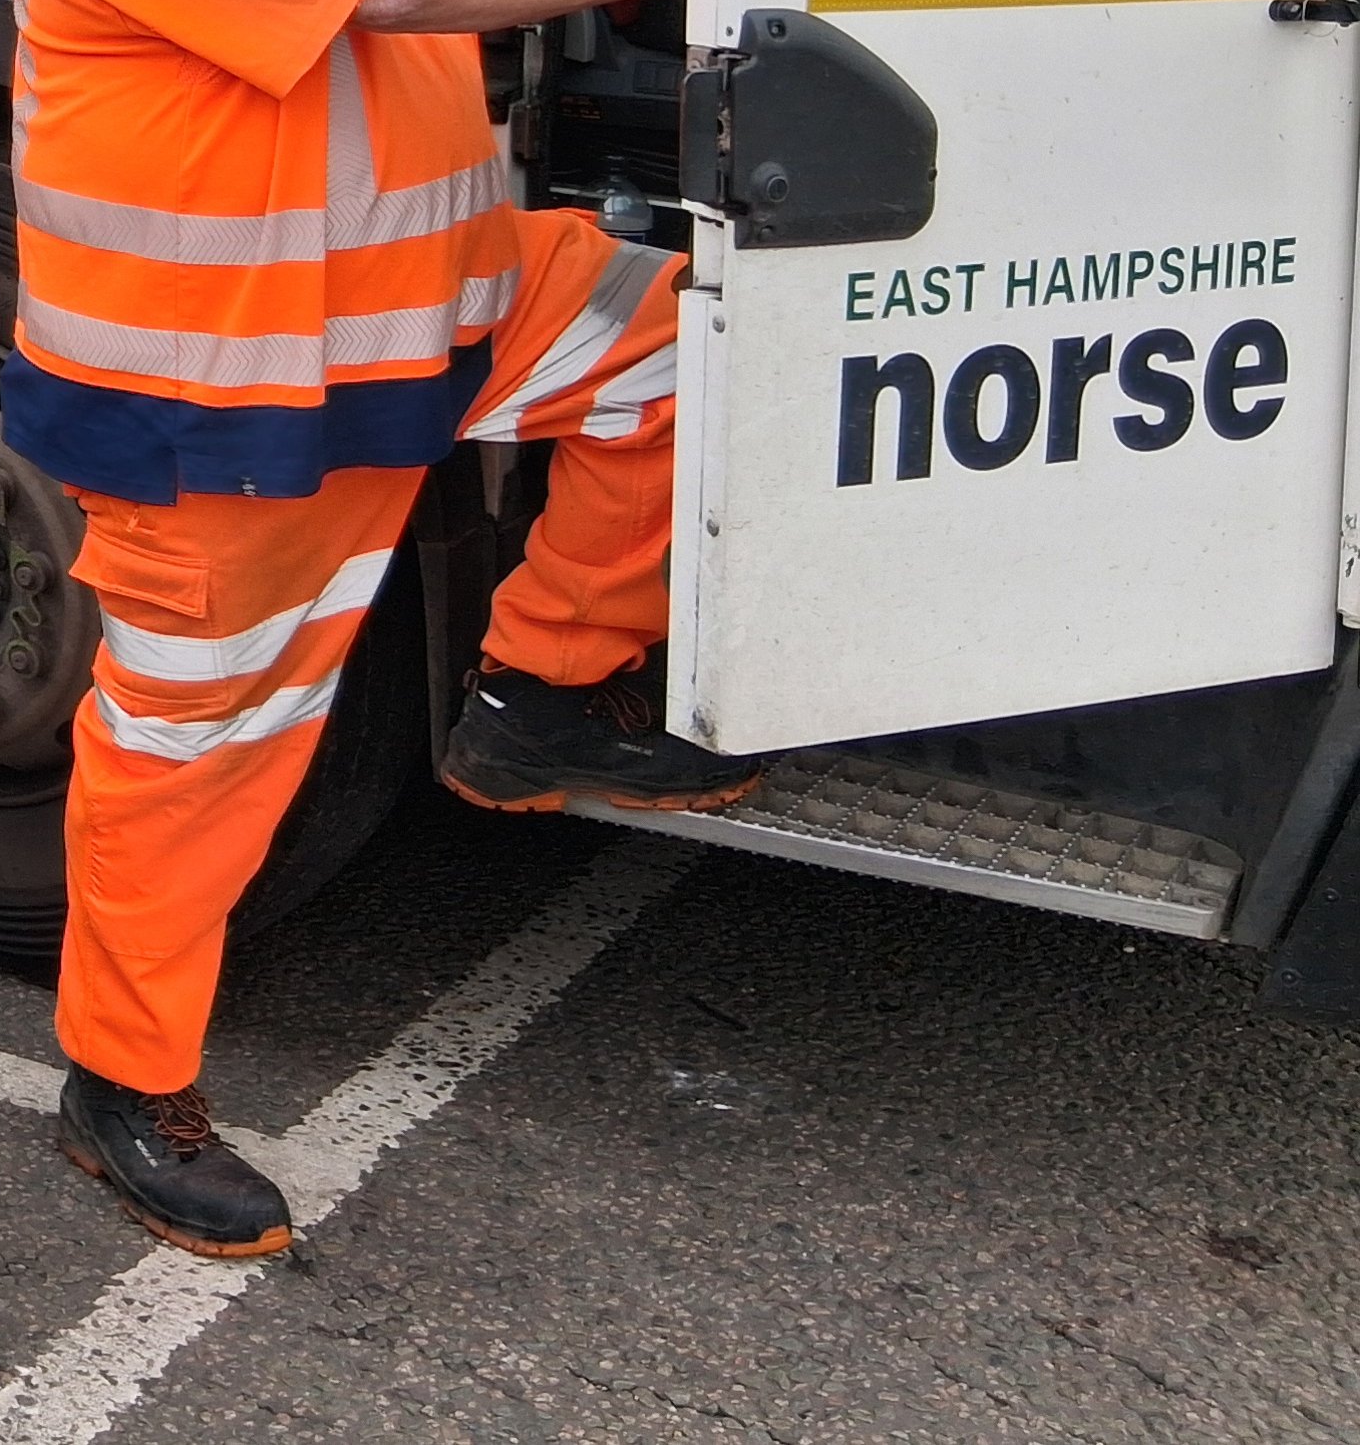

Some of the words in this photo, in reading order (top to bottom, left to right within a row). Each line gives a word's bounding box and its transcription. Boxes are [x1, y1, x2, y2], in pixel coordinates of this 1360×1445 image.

[846, 262, 985, 322] EAST
[1006, 237, 1297, 309] HAMPSHIRE
[836, 317, 1289, 488] norse
